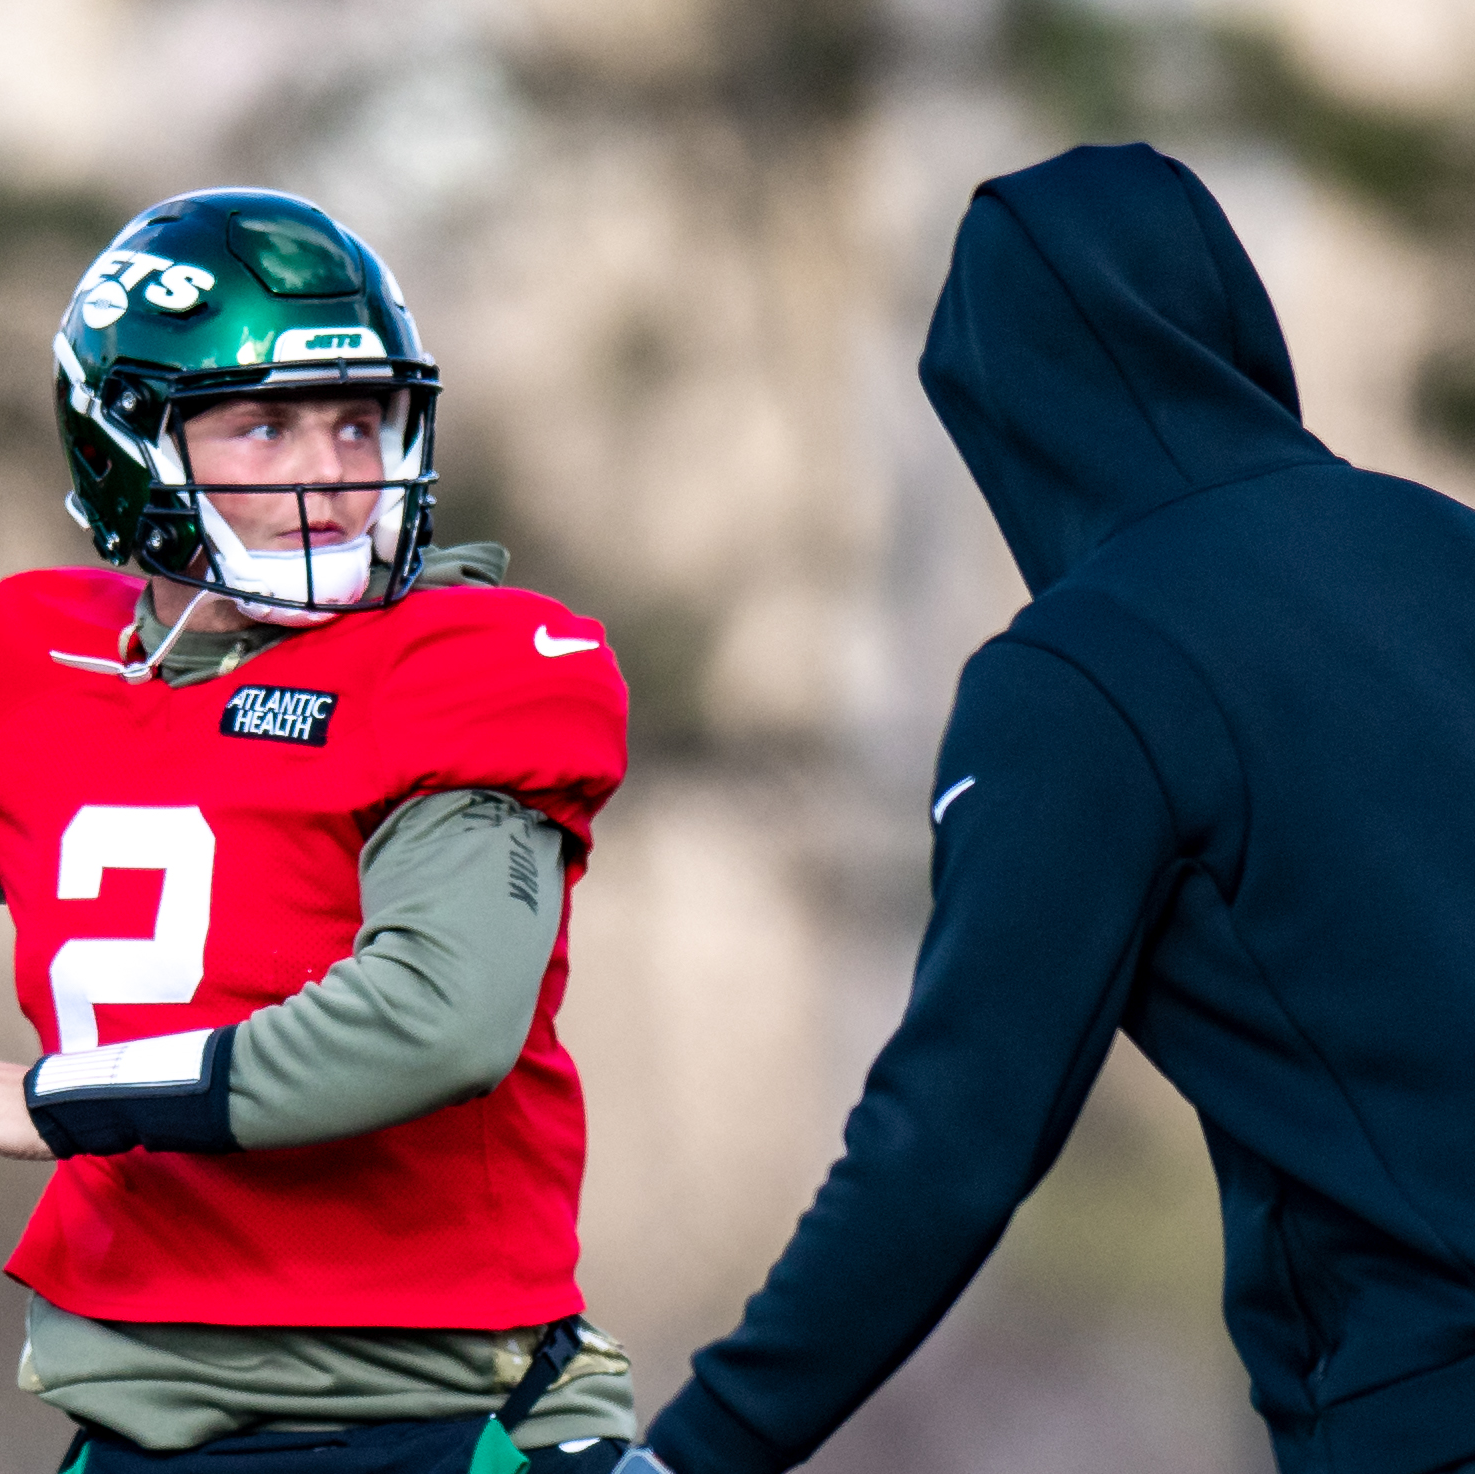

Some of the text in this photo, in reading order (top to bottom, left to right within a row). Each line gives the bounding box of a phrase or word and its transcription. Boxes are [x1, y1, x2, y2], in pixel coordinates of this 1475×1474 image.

[82, 250, 216, 312] ETS
[306, 333, 362, 349] JETS
[226, 688, 333, 719] ATLANTIC
[234, 709, 313, 740] HEALTH
[49, 804, 216, 1055] 2
